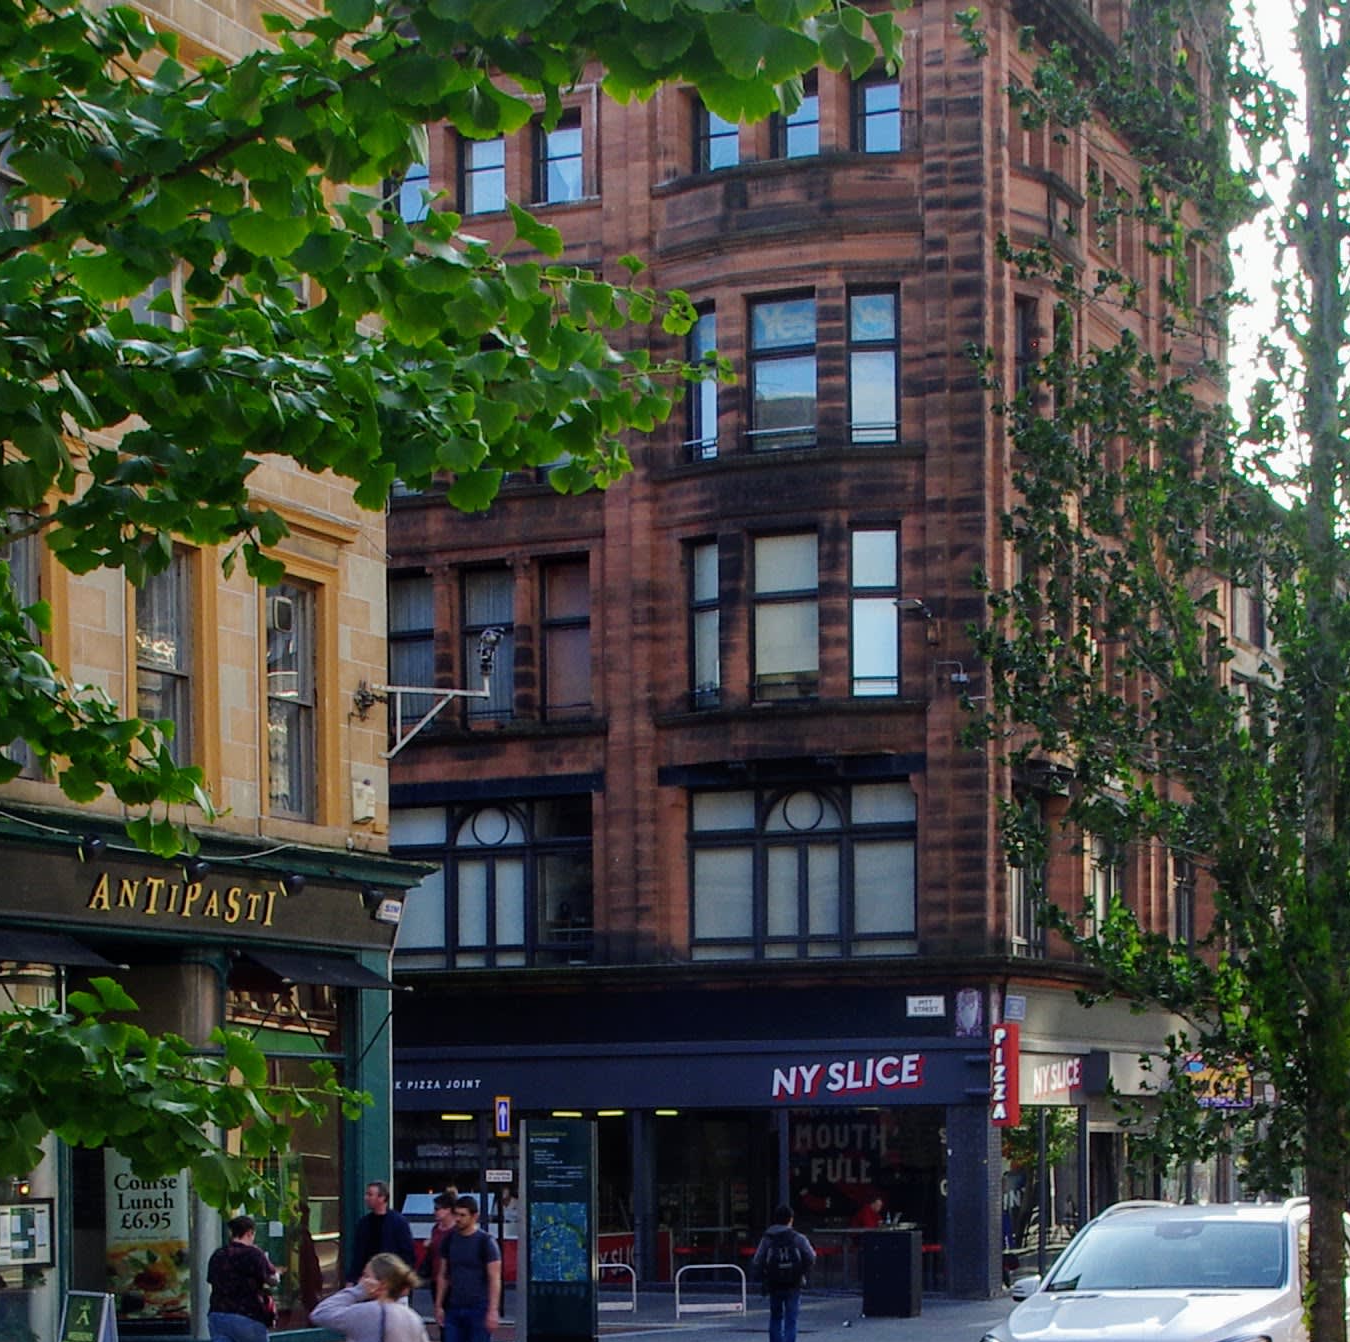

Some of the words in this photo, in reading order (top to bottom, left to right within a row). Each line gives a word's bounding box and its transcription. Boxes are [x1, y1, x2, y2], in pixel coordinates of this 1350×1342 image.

[88, 872, 277, 927] ANTIPASTI
[407, 1080, 441, 1090] PIZZA
[446, 1079, 482, 1089] JOINT
[771, 1063, 822, 1099] NY
[825, 1053, 922, 1093] SLICE
[992, 1028, 1006, 1120] PIZZA
[1033, 1064, 1051, 1095] NY
[1050, 1057, 1081, 1091] SLICE
[113, 1172, 178, 1191] Course
[117, 1191, 175, 1210] Lunch
[120, 1211, 172, 1231] £6.95
